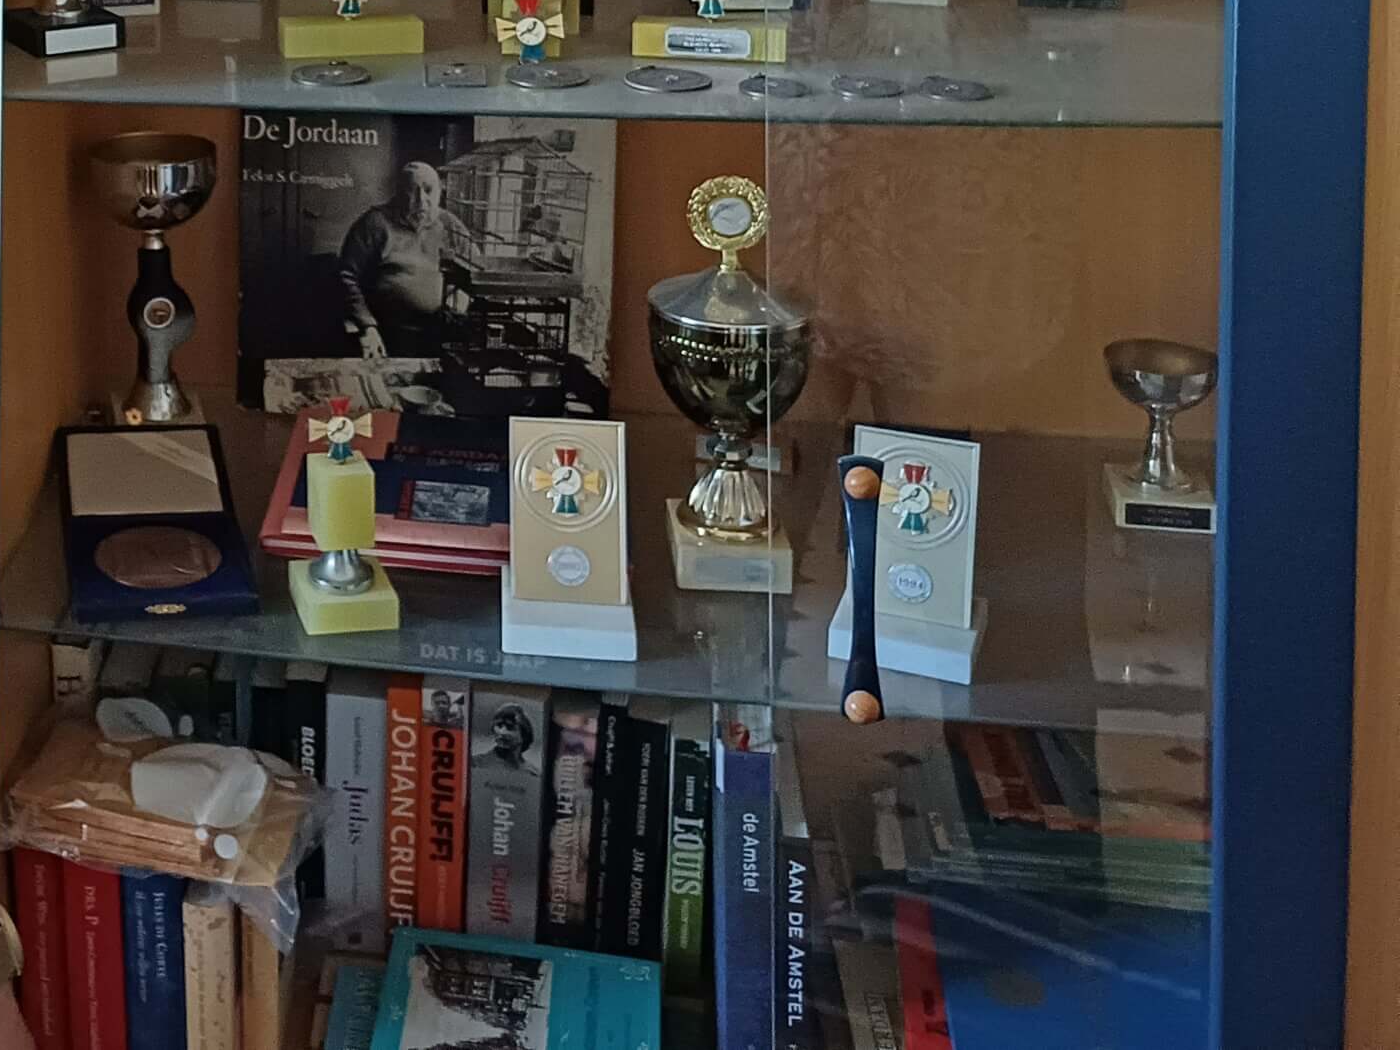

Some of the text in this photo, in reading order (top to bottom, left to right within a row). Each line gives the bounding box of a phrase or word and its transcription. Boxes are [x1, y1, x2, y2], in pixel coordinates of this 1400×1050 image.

[244, 115, 378, 149] De Jordaan
[419, 643, 460, 661] DAT
[466, 647, 485, 665] IS
[341, 780, 369, 845] Judas
[389, 708, 417, 928] JOHAN CRUIJF
[430, 729, 456, 863] CRUIJFF!
[555, 815, 580, 850] VAN
[487, 797, 516, 925] Johan Cruijff
[671, 815, 705, 896] LOUIS
[742, 813, 760, 893] de Amstel
[627, 849, 646, 946] JAN JONGBLOED
[787, 860, 807, 1027] AAN DE AMSTEL
